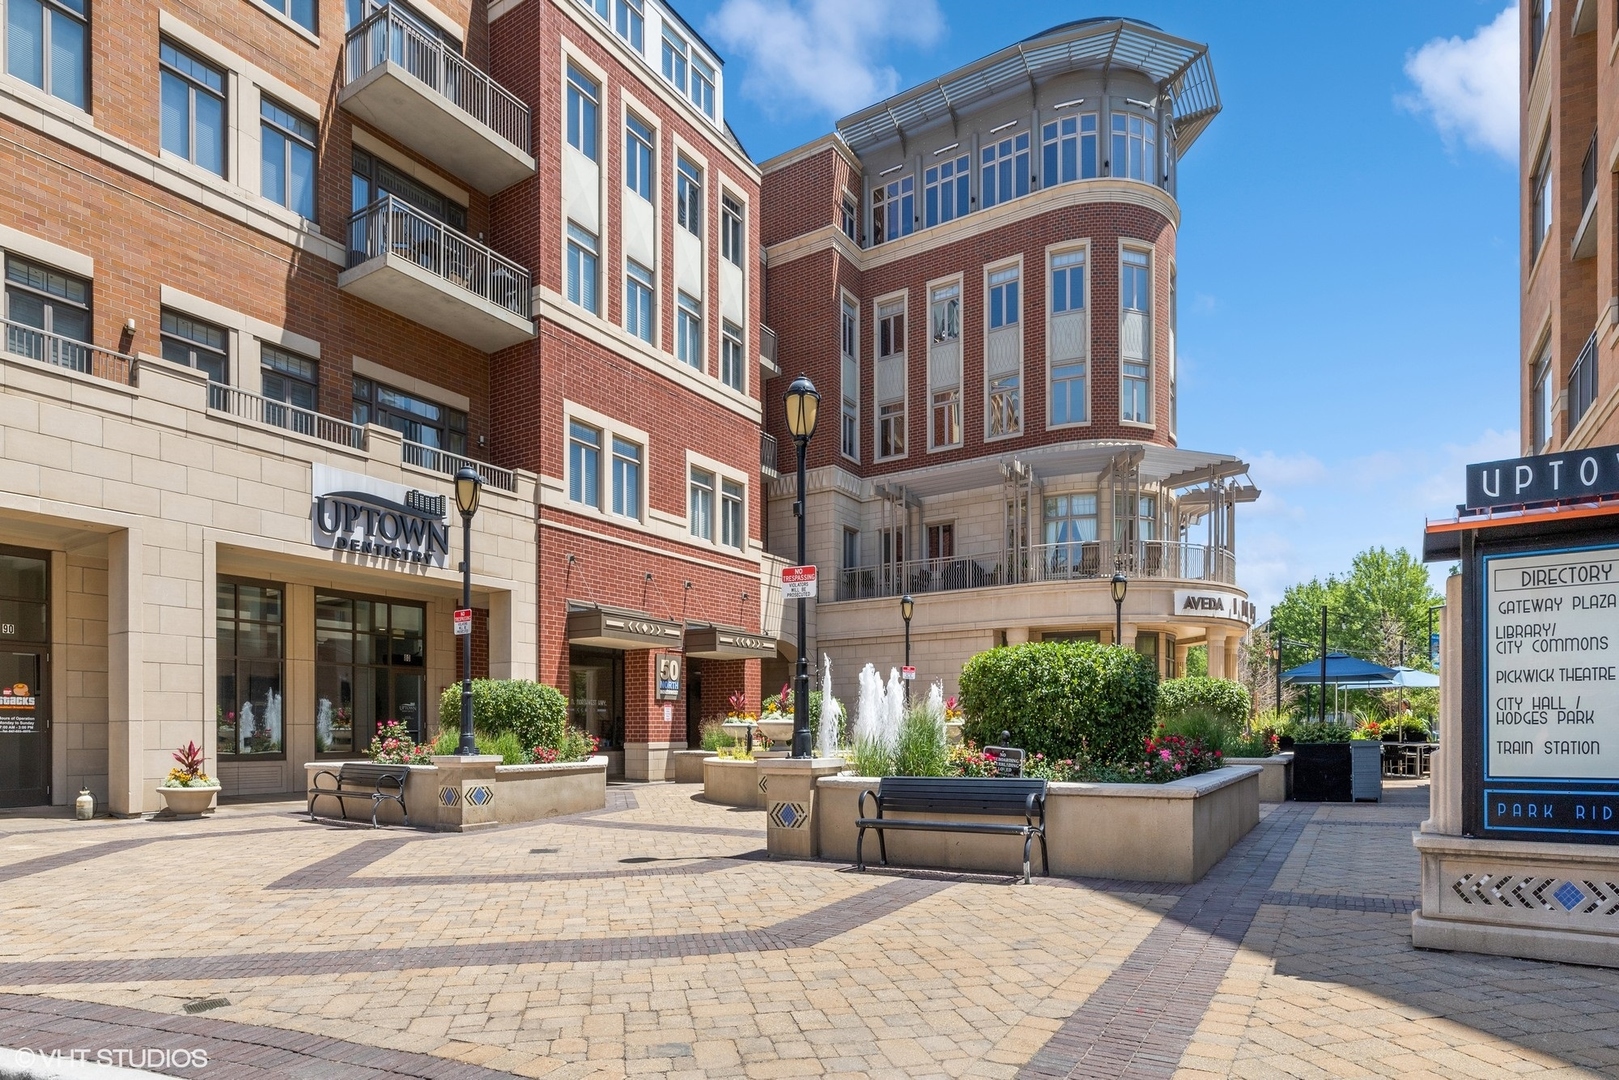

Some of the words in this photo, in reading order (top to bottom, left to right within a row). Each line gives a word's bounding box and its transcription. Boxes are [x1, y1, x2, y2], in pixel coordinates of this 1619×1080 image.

[1482, 453, 1619, 498] UPTO
[315, 495, 449, 555] UPTOWN
[336, 536, 433, 565] DENTISTRY
[783, 573, 815, 582] TRESPASSING
[1521, 563, 1613, 587] DIRECTORY
[1183, 595, 1224, 611] AVEDA
[1498, 597, 1563, 615] GATEWAY
[1572, 593, 1616, 610] PLAZA
[2, 624, 14, 634] 90
[1496, 623, 1557, 640] LIBRARY/
[1496, 640, 1523, 655] CITY
[1532, 636, 1609, 653] COMMONS
[660, 659, 679, 680] 50
[1496, 669, 1554, 684] PICKWICK
[1559, 666, 1616, 682] THEATRE
[660, 680, 679, 689] NORTH
[1496, 697, 1523, 711] CITY
[1532, 696, 1566, 710] HALL
[1496, 711, 1548, 725] HODGES
[1557, 710, 1595, 724] PARK
[1497, 741, 1534, 754] TRAIN
[1544, 741, 1600, 755] STATION
[1497, 803, 1553, 818] PARK
[1576, 804, 1613, 820] RID
